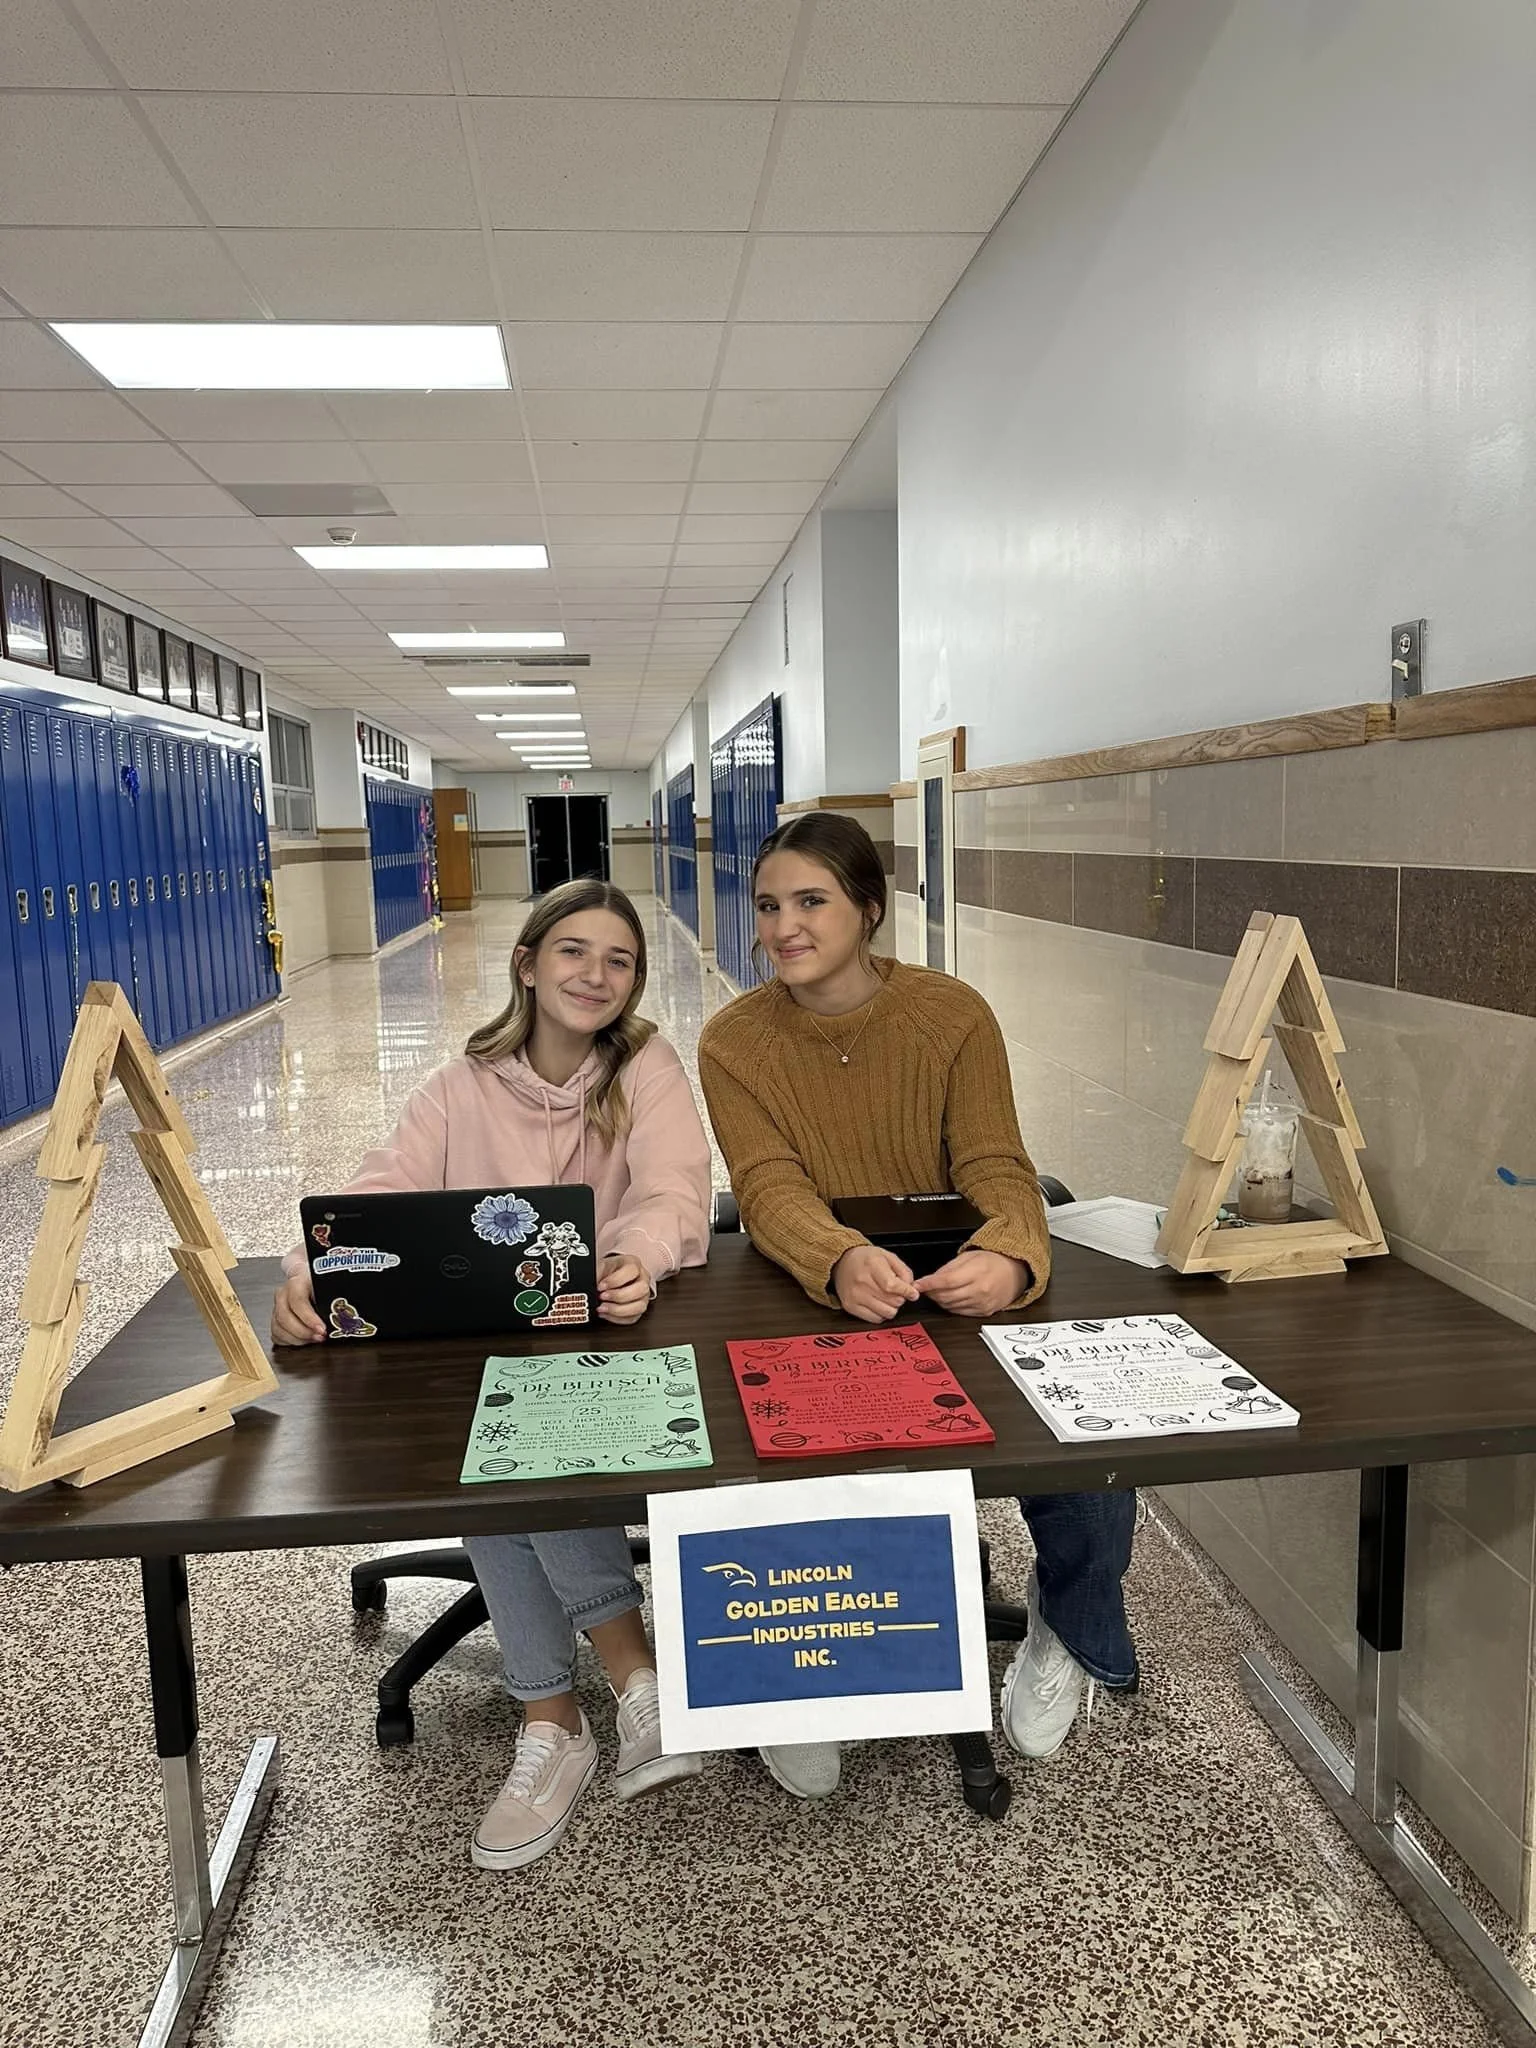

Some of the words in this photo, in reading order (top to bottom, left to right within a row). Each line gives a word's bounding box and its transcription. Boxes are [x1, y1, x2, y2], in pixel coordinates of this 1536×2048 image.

[321, 1254, 386, 1269] OPPORTUNITY
[1042, 1348, 1070, 1357] DR
[1079, 1340, 1176, 1354] BERTSCH
[773, 1362, 801, 1372] DR
[812, 1352, 907, 1368] BERTSCH
[1118, 1368, 1143, 1377] 25
[523, 1383, 551, 1393] DR
[563, 1376, 660, 1390] BERTSCH
[839, 1383, 862, 1393] 25
[579, 1406, 601, 1417] 25
[768, 1564, 853, 1586] LINCOLN
[726, 1595, 819, 1621] GOLDEN
[825, 1591, 899, 1611] EAGLE
[753, 1620, 876, 1645] INDUSTRIES
[794, 1648, 837, 1668] INC.
